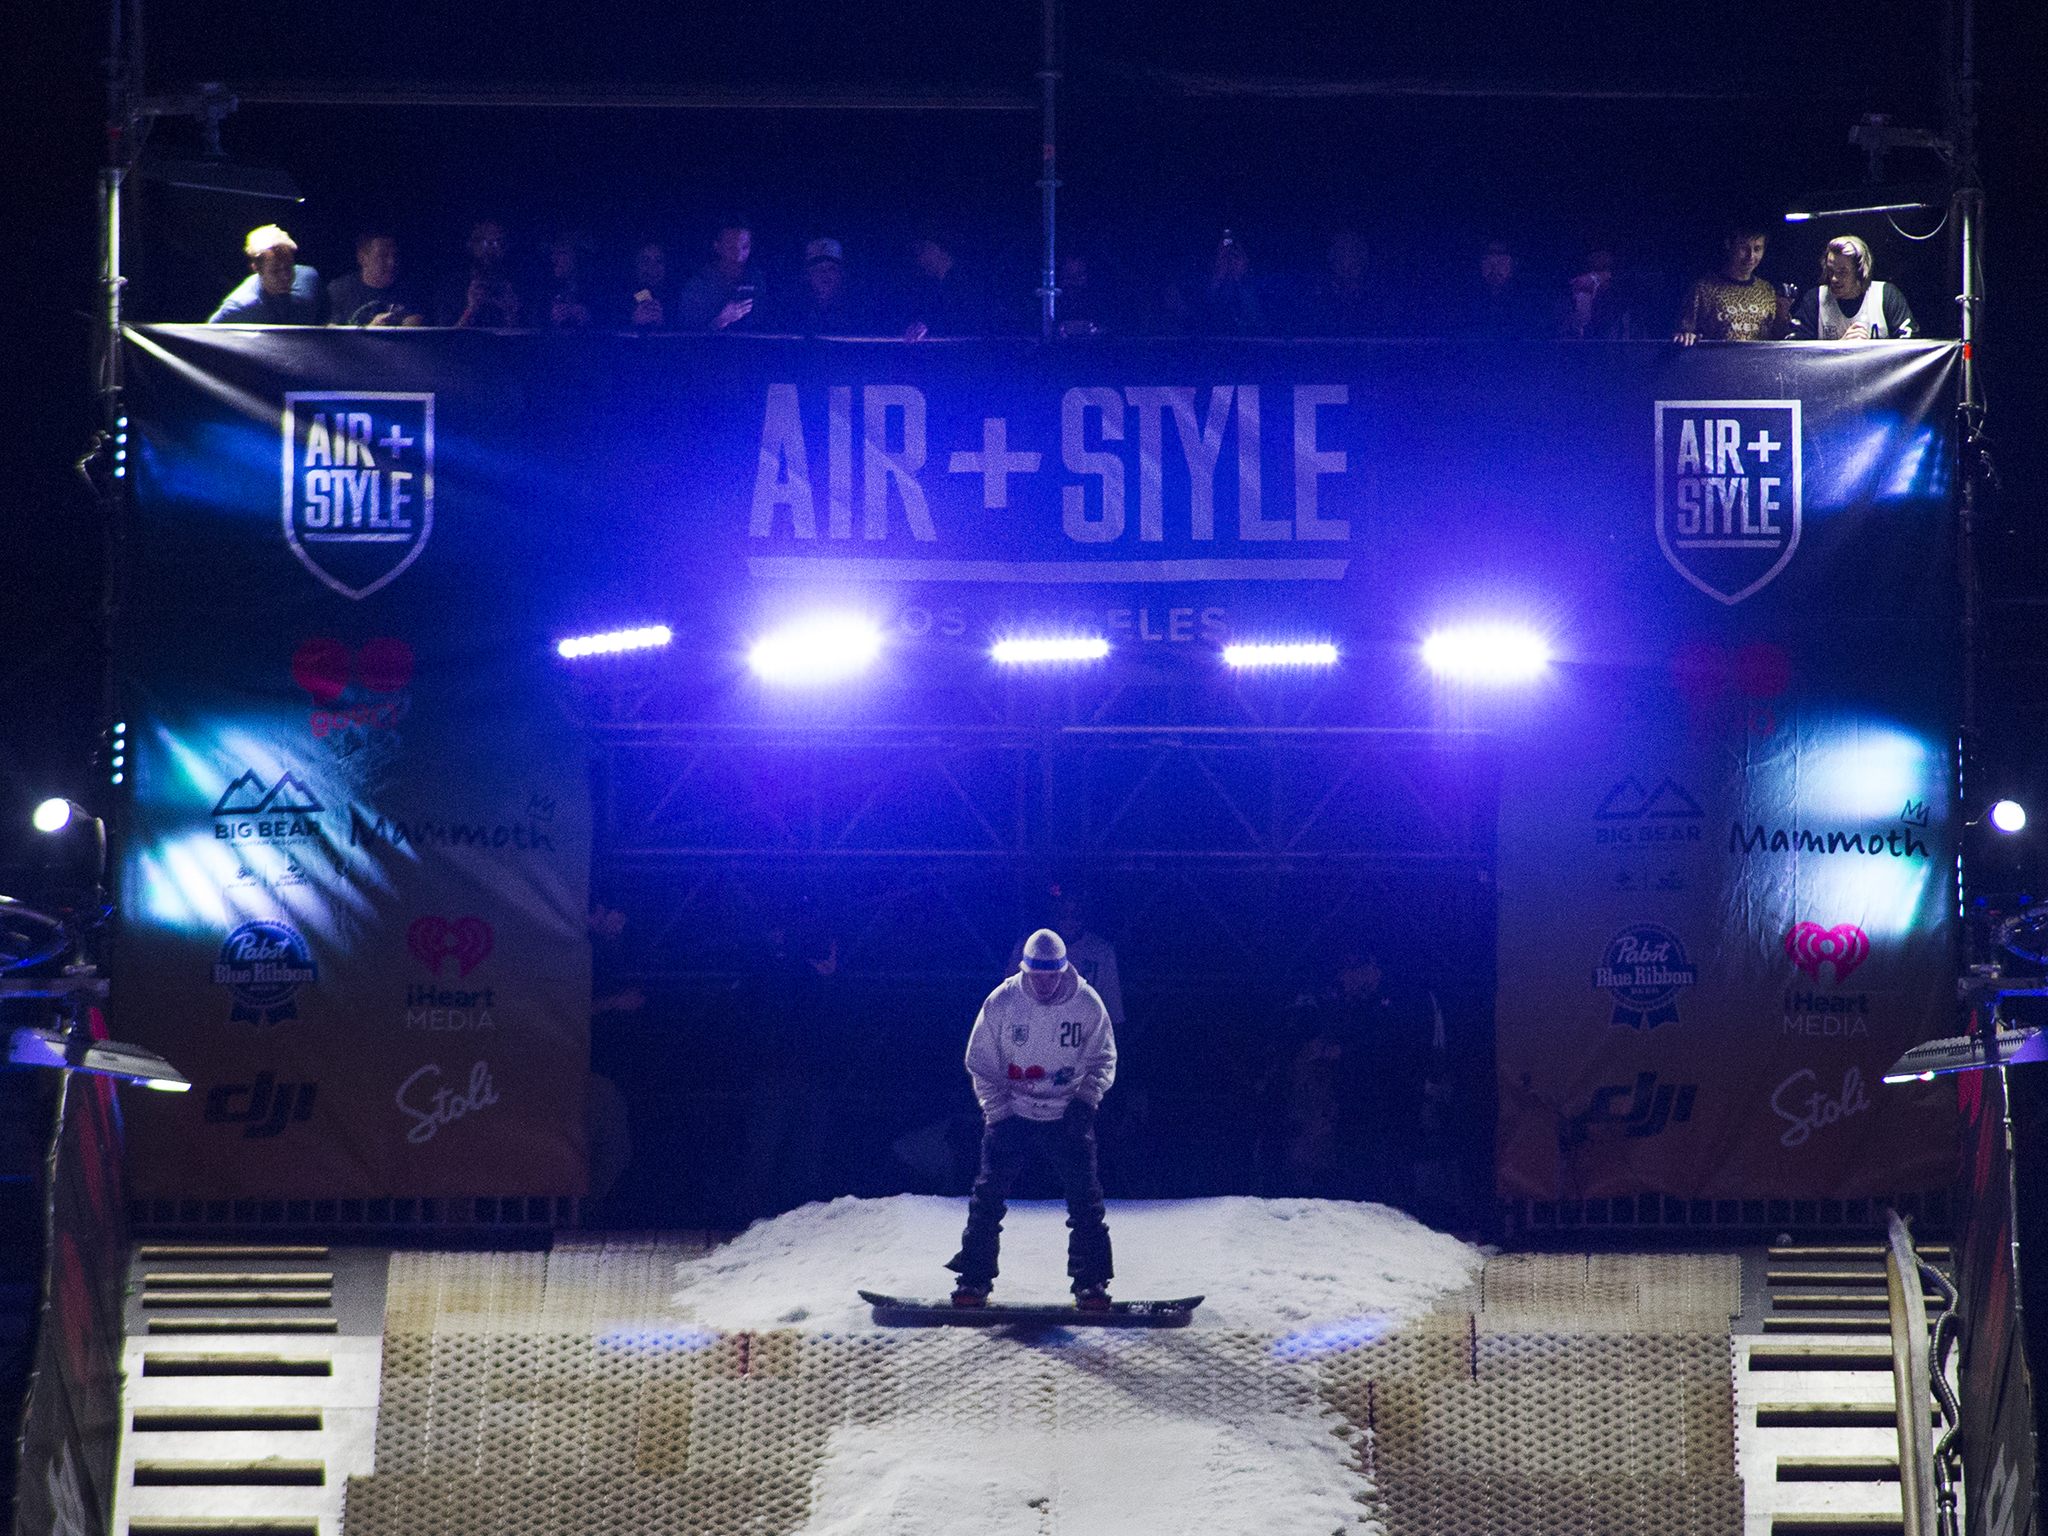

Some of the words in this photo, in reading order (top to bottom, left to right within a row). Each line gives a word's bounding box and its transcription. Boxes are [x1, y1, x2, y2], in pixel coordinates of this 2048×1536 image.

[305, 413, 376, 467] AIR
[1677, 419, 1745, 474] AIR
[749, 383, 937, 542] AIR
[1061, 384, 1351, 543] STYLE
[305, 469, 413, 528] STYLE
[1677, 477, 1781, 534] STYLE
[215, 822, 253, 839] BIG
[259, 820, 321, 838] BEAR
[1596, 827, 1633, 844] BIG
[1639, 825, 1701, 842] BEAR
[1729, 820, 1929, 857] Mammoth
[234, 931, 292, 961] Pabst
[1616, 936, 1671, 963] Pabst
[213, 963, 252, 984] Blue
[254, 962, 315, 983] Ribbon
[1596, 966, 1632, 987] Blue
[1634, 965, 1695, 985] Ribbon
[405, 1009, 496, 1030] MEDIA
[1060, 1021, 1082, 1048] 20
[1783, 1015, 1870, 1036] MEDIA
[395, 1060, 501, 1144] Stoli
[1771, 1065, 1871, 1147] Stoli
